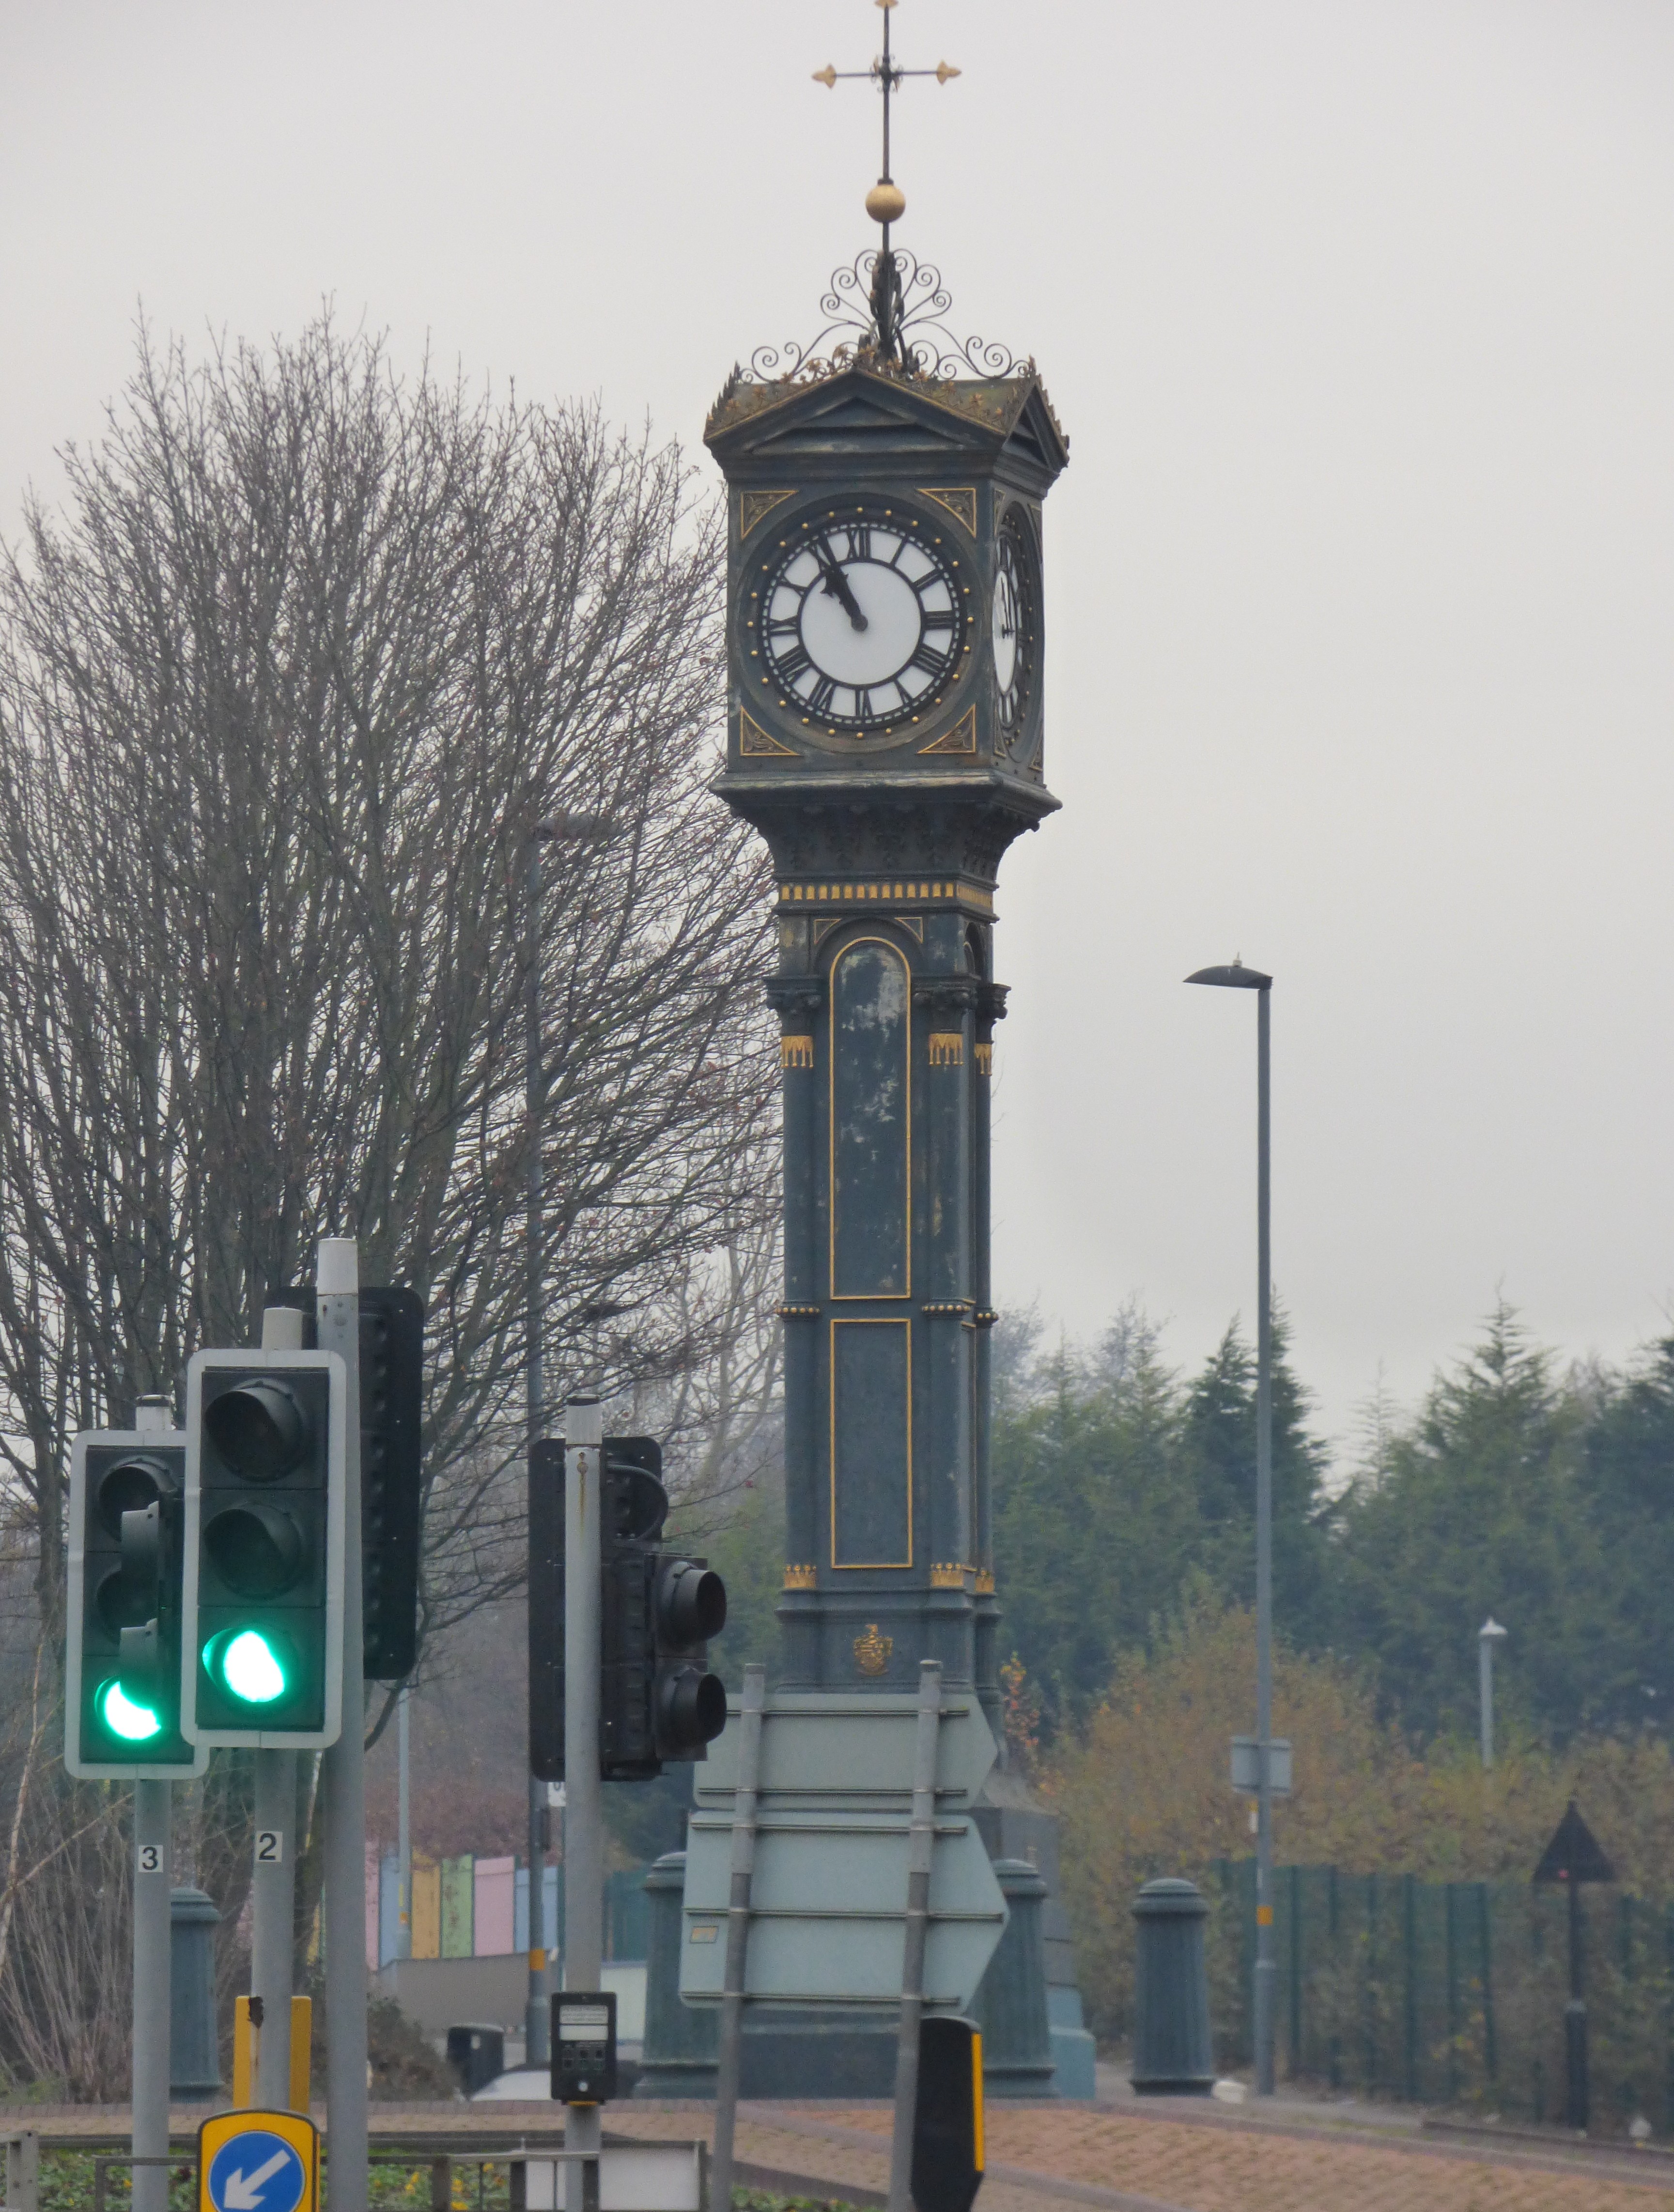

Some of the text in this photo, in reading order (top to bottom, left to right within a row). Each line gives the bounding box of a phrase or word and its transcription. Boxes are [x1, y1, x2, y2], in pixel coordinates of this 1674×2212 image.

[849, 530, 871, 559] XII
[890, 536, 907, 564] I
[912, 568, 944, 590] II
[769, 617, 798, 635] IX
[922, 611, 952, 630] III
[775, 646, 811, 684] VIII
[807, 679, 837, 711] VII
[855, 688, 872, 717] VI
[895, 681, 914, 705] V
[142, 1846, 158, 1870] 3
[259, 1833, 277, 1860] 2
